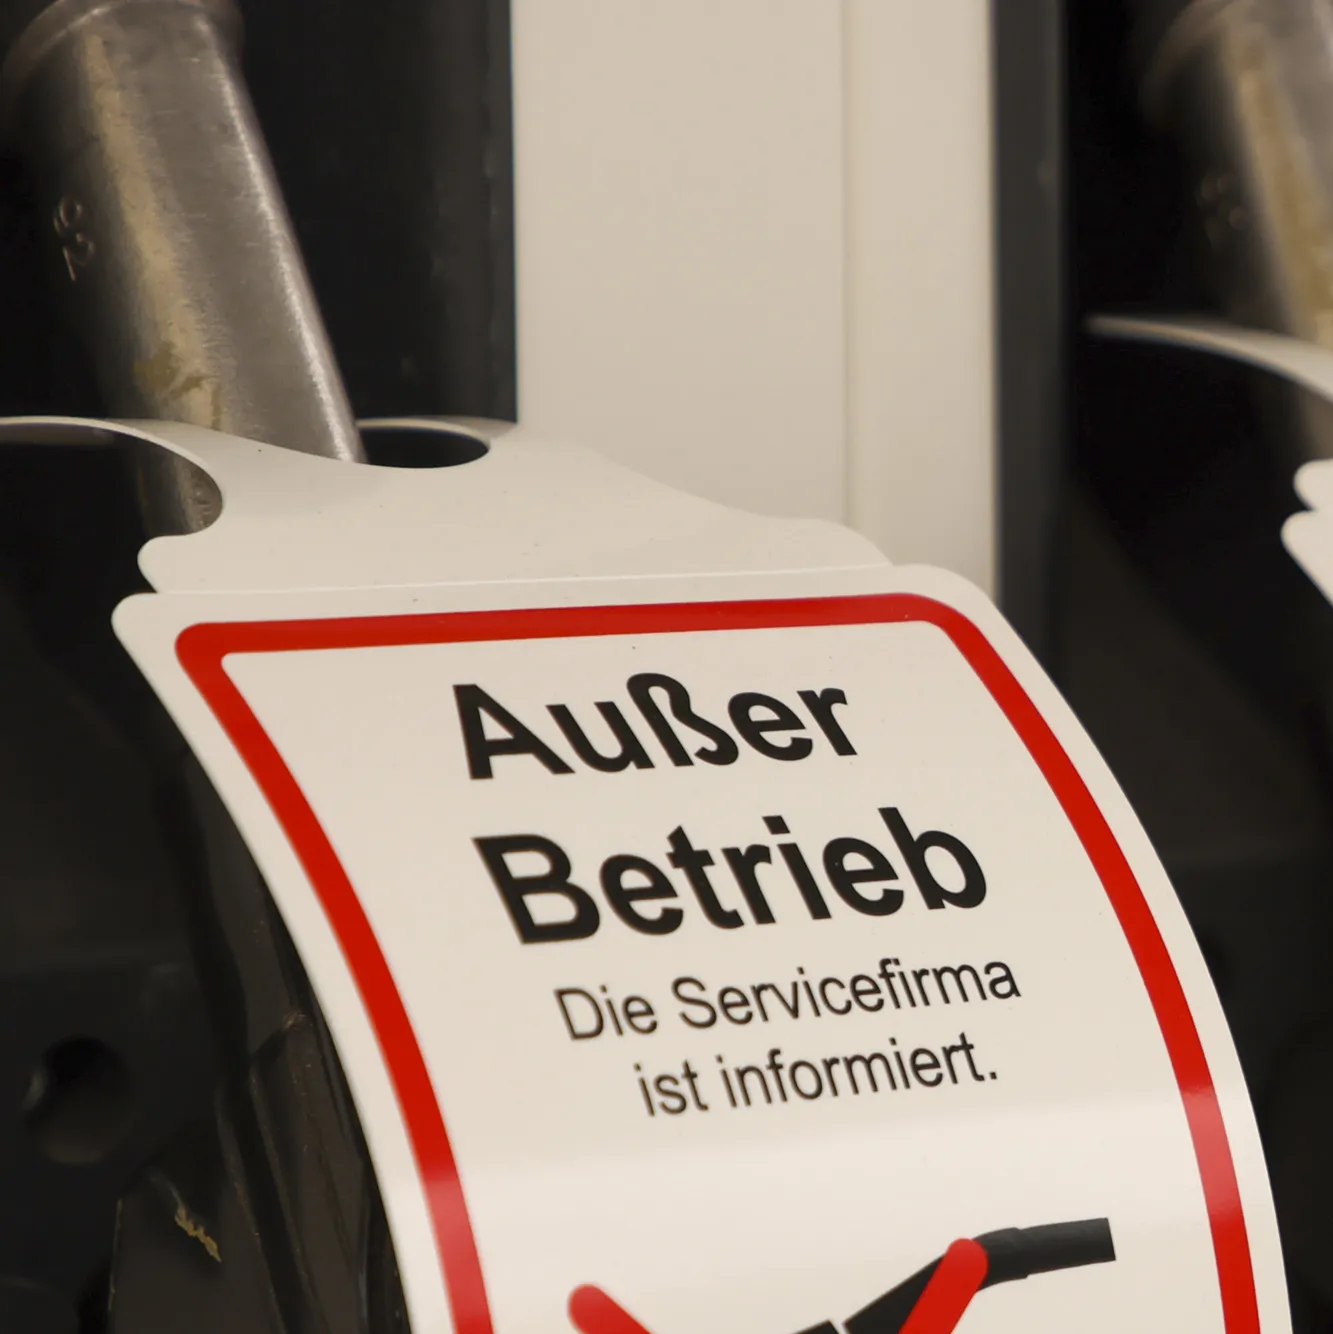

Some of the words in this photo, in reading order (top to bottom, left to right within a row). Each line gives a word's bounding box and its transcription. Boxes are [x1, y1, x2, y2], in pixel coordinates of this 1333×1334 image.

[452, 673, 857, 780] Außer
[472, 807, 986, 944] Betrieb
[554, 985, 657, 1040] Die
[672, 958, 1021, 1029] Servicefirma
[634, 1060, 708, 1116] ist
[716, 1032, 997, 1107] informiert.
